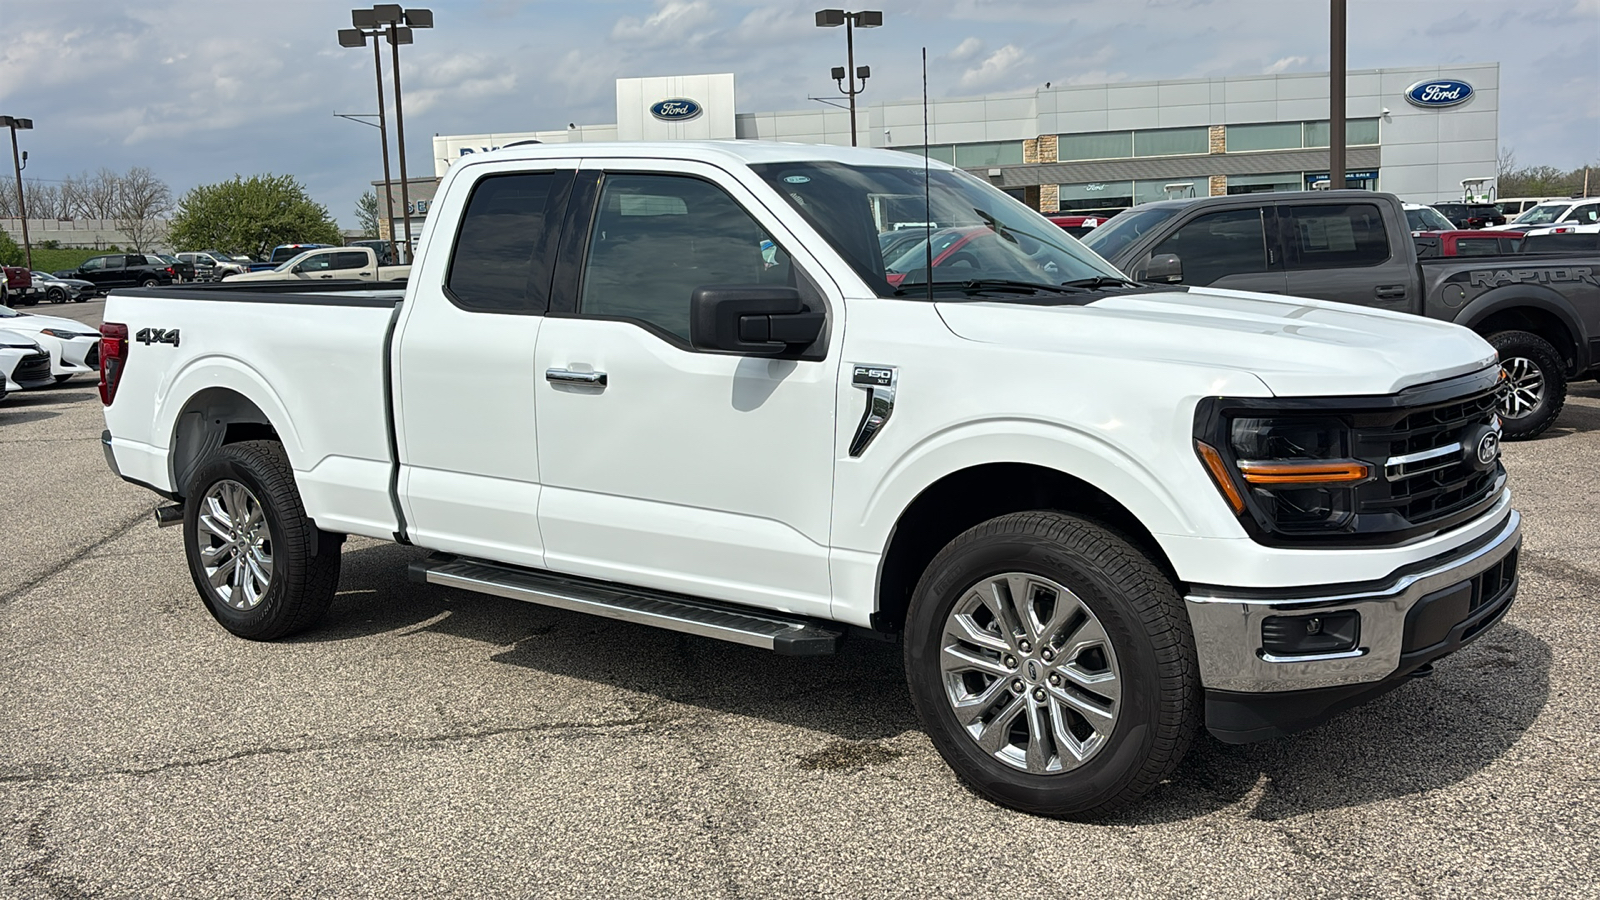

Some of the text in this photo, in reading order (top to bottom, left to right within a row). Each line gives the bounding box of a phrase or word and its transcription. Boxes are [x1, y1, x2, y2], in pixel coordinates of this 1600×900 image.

[1422, 84, 1461, 101] Ford
[660, 102, 689, 115] Ford
[1469, 267, 1600, 287] RAPTOR
[855, 369, 891, 378] F-150
